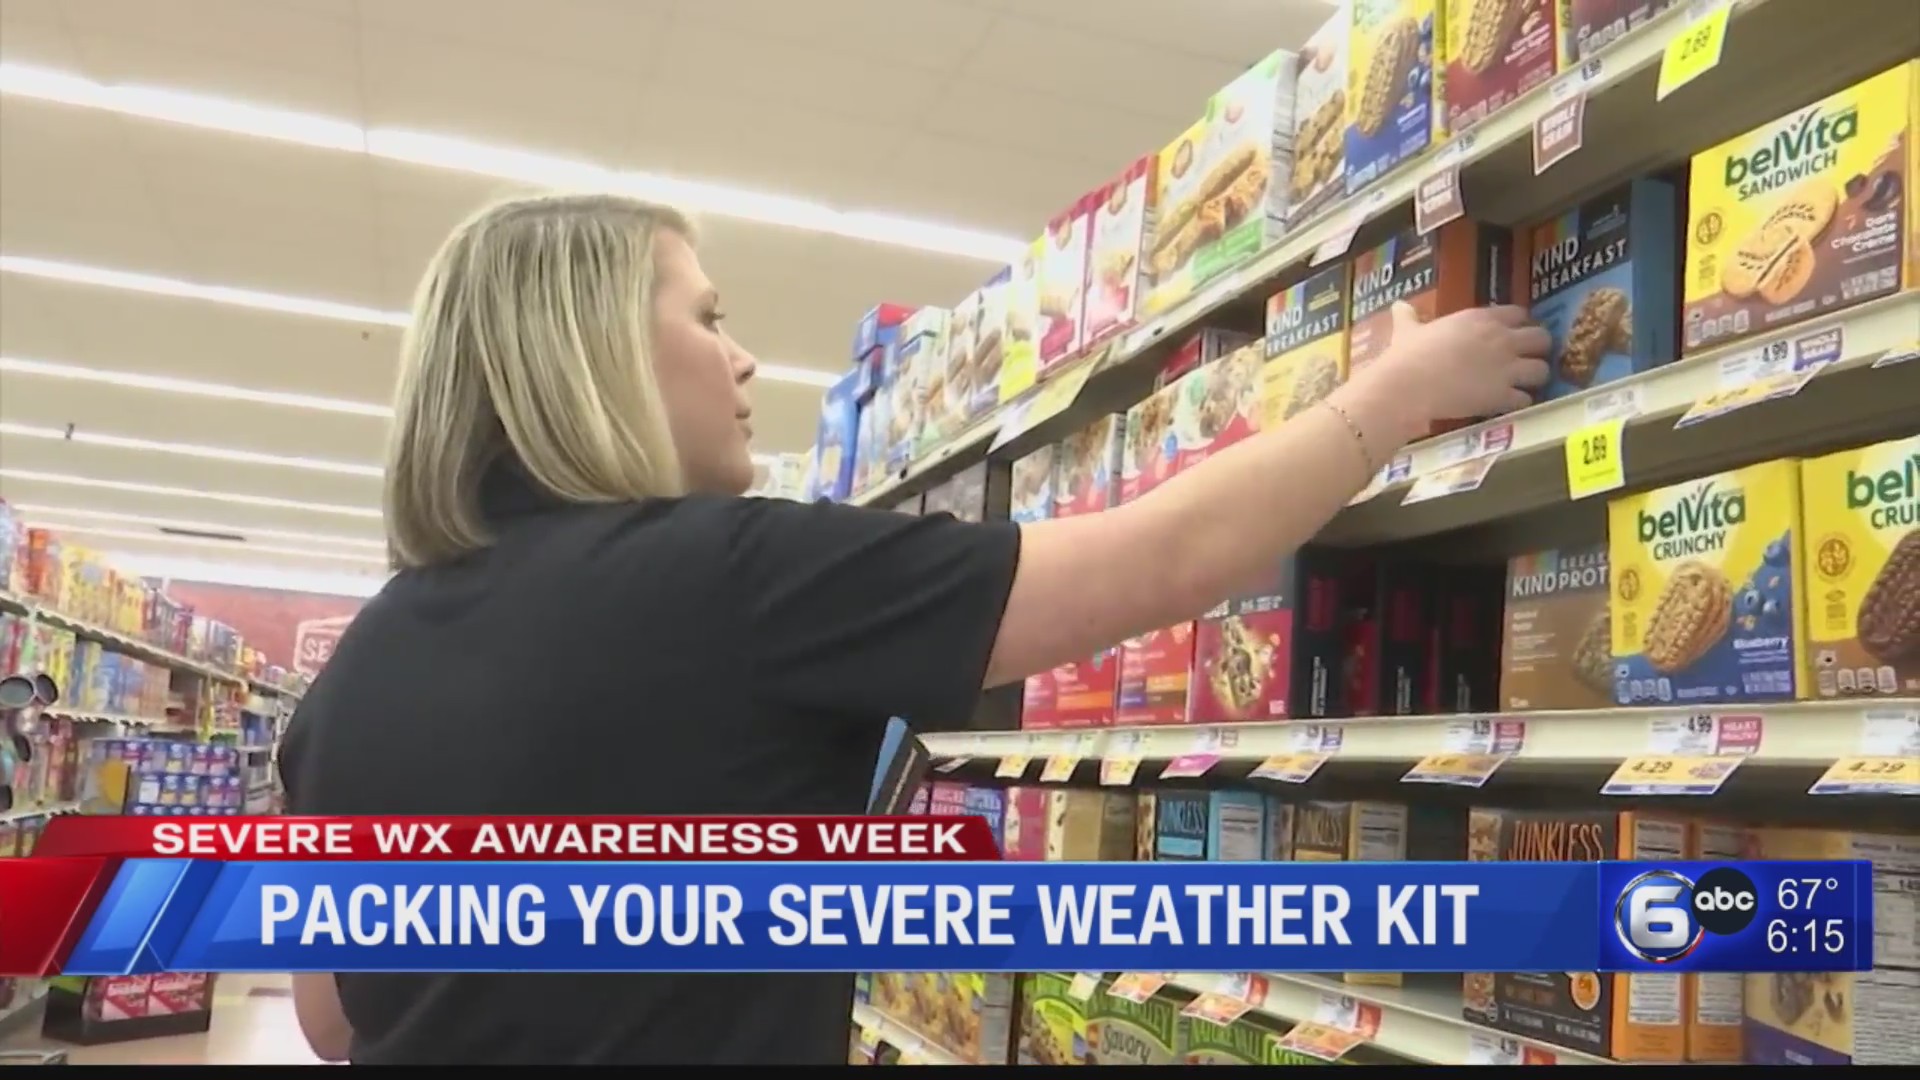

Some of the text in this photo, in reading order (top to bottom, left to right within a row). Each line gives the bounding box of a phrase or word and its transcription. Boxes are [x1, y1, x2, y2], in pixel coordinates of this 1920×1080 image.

[1725, 107, 1858, 187] belVita
[1738, 149, 1838, 201] SANDWICH
[1531, 236, 1579, 279] KIND
[1531, 238, 1627, 300] BREAKFAST
[1352, 268, 1433, 321] BREAKFAST
[1353, 262, 1393, 298] KIND
[1266, 312, 1340, 357] BREAKFAST
[1270, 306, 1303, 335] KIND
[1637, 481, 1747, 543] belVita
[1653, 530, 1728, 562] CRUNCHY
[1512, 571, 1557, 597] KIND
[304, 637, 338, 662] SE
[1733, 636, 1789, 649] Blueberry
[1631, 760, 1673, 773] 4.29
[1849, 760, 1906, 774] 4.29
[1508, 820, 1605, 861] JUNKLESS
[1104, 1024, 1150, 1064] Savory
